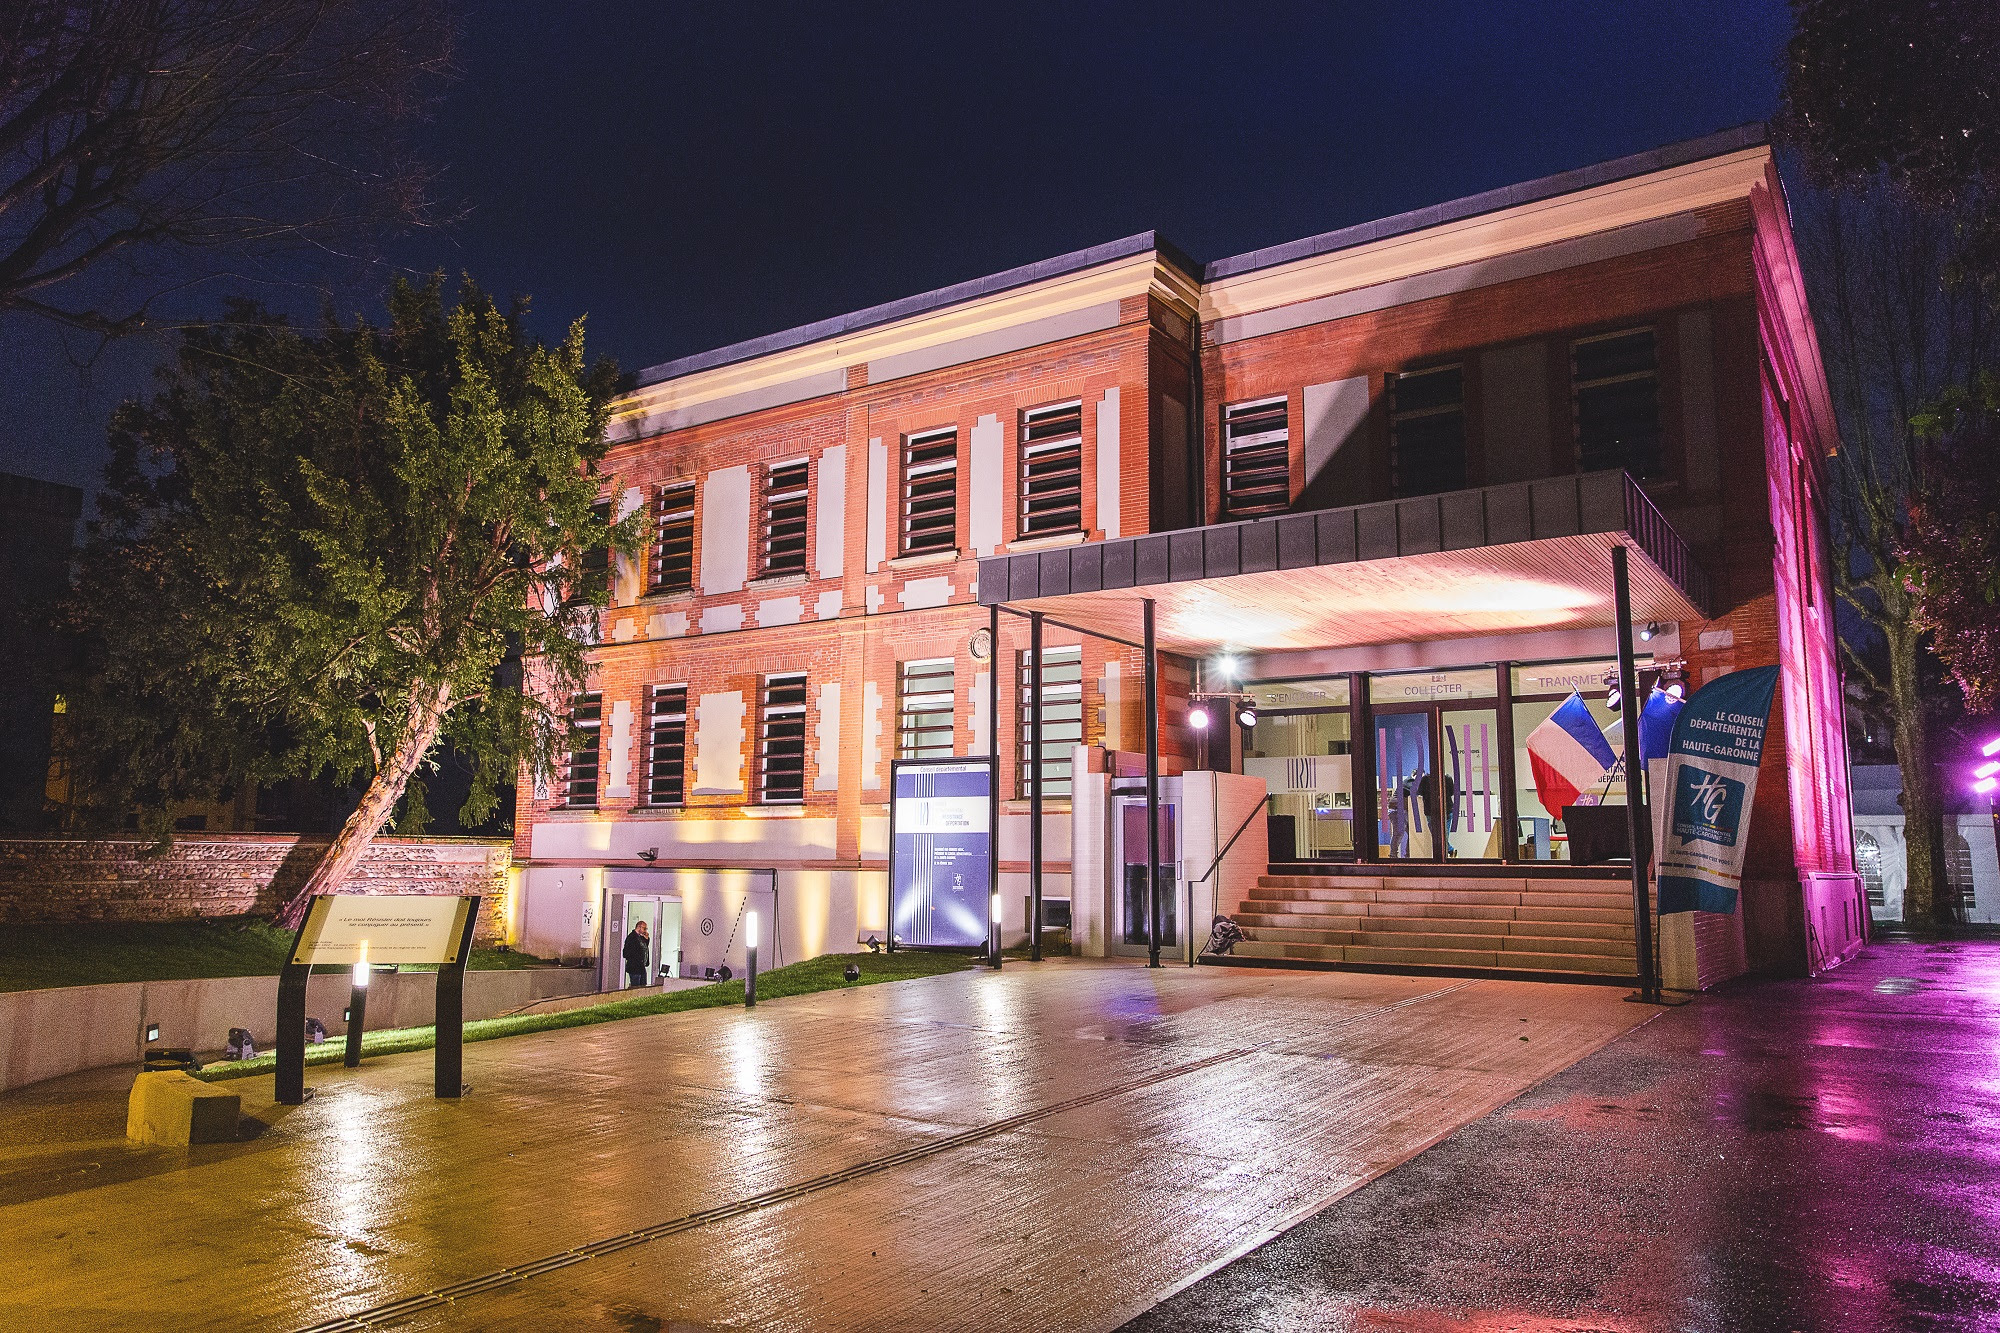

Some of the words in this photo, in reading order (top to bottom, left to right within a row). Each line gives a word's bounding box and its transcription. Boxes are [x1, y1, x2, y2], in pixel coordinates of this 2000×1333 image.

[1404, 684, 1462, 695] COLLECTER
[1270, 692, 1326, 703] S'ENGAGER
[1716, 711, 1726, 721] LE
[1728, 713, 1764, 728] CONSEIL
[1689, 717, 1762, 739] DÉPARTEMENTAL
[1682, 740, 1759, 761] HAUTE-GARONNE
[1735, 737, 1747, 748] DE
[1749, 739, 1760, 750] LA
